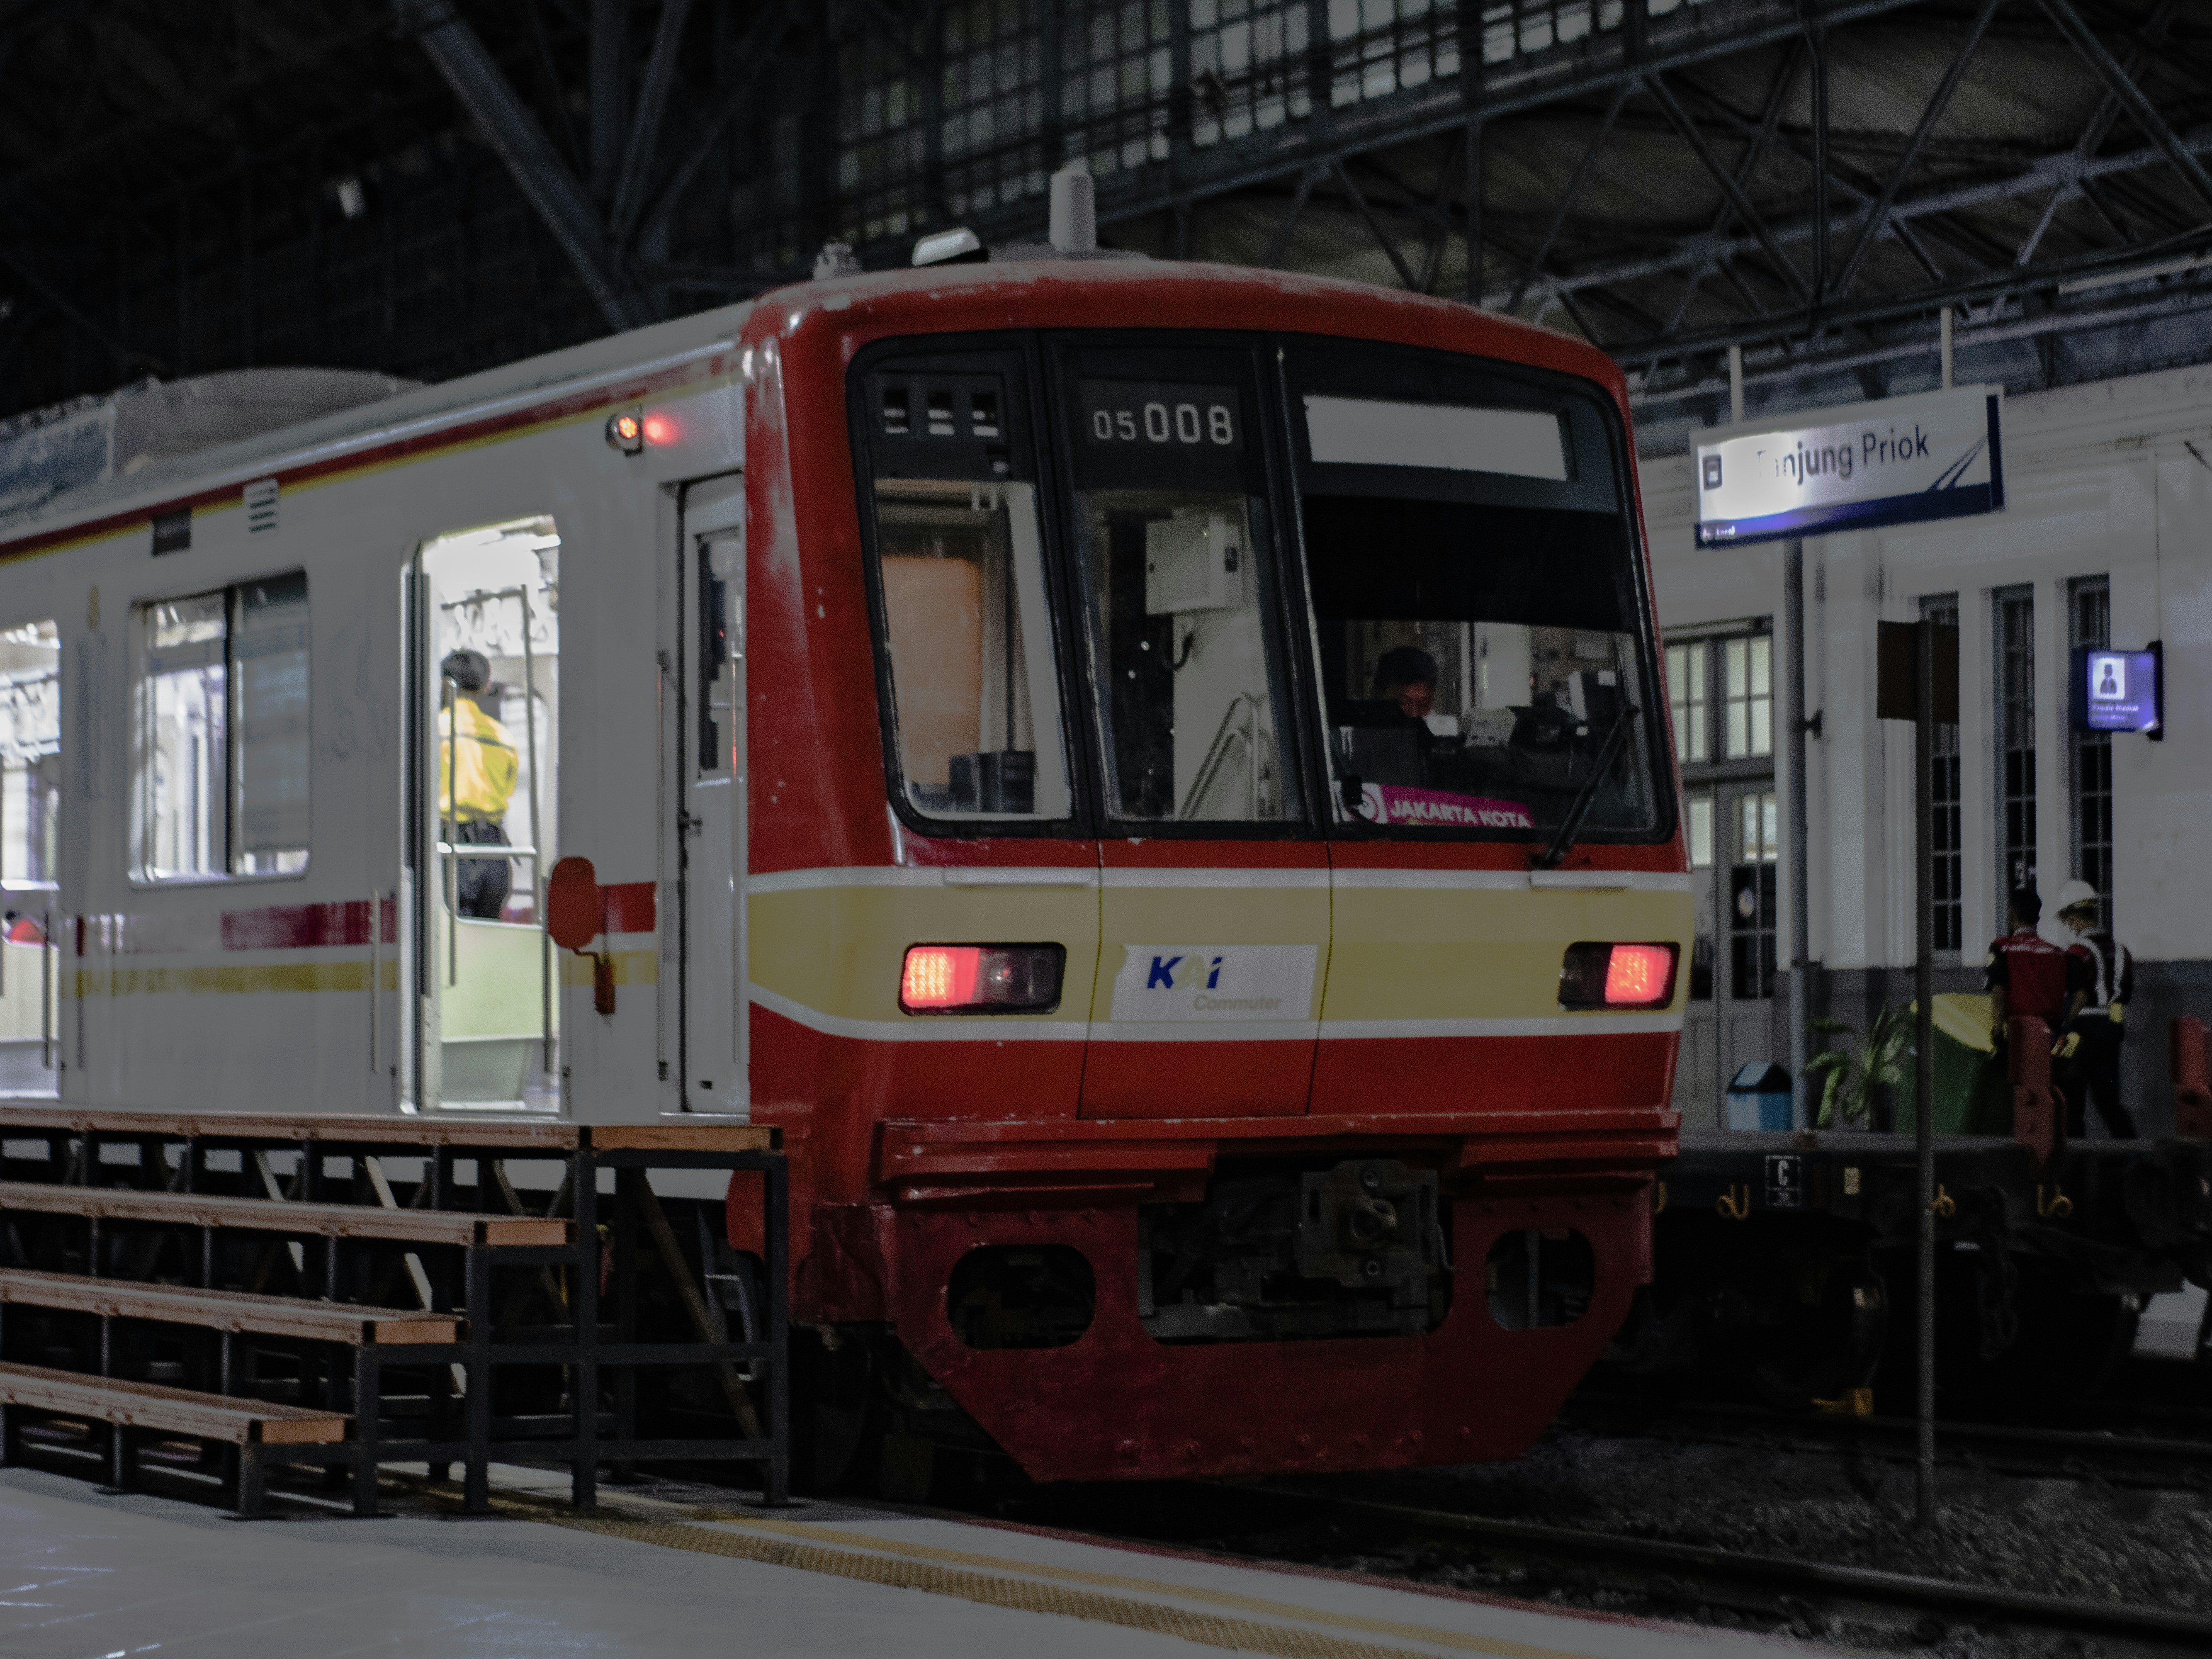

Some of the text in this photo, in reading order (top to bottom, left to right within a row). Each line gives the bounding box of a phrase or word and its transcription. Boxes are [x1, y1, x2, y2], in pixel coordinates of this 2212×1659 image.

[1862, 424, 1929, 463] Priok
[1390, 800, 1532, 828] JAKARTA KOTA
[1194, 995, 1282, 1011] Commuter
